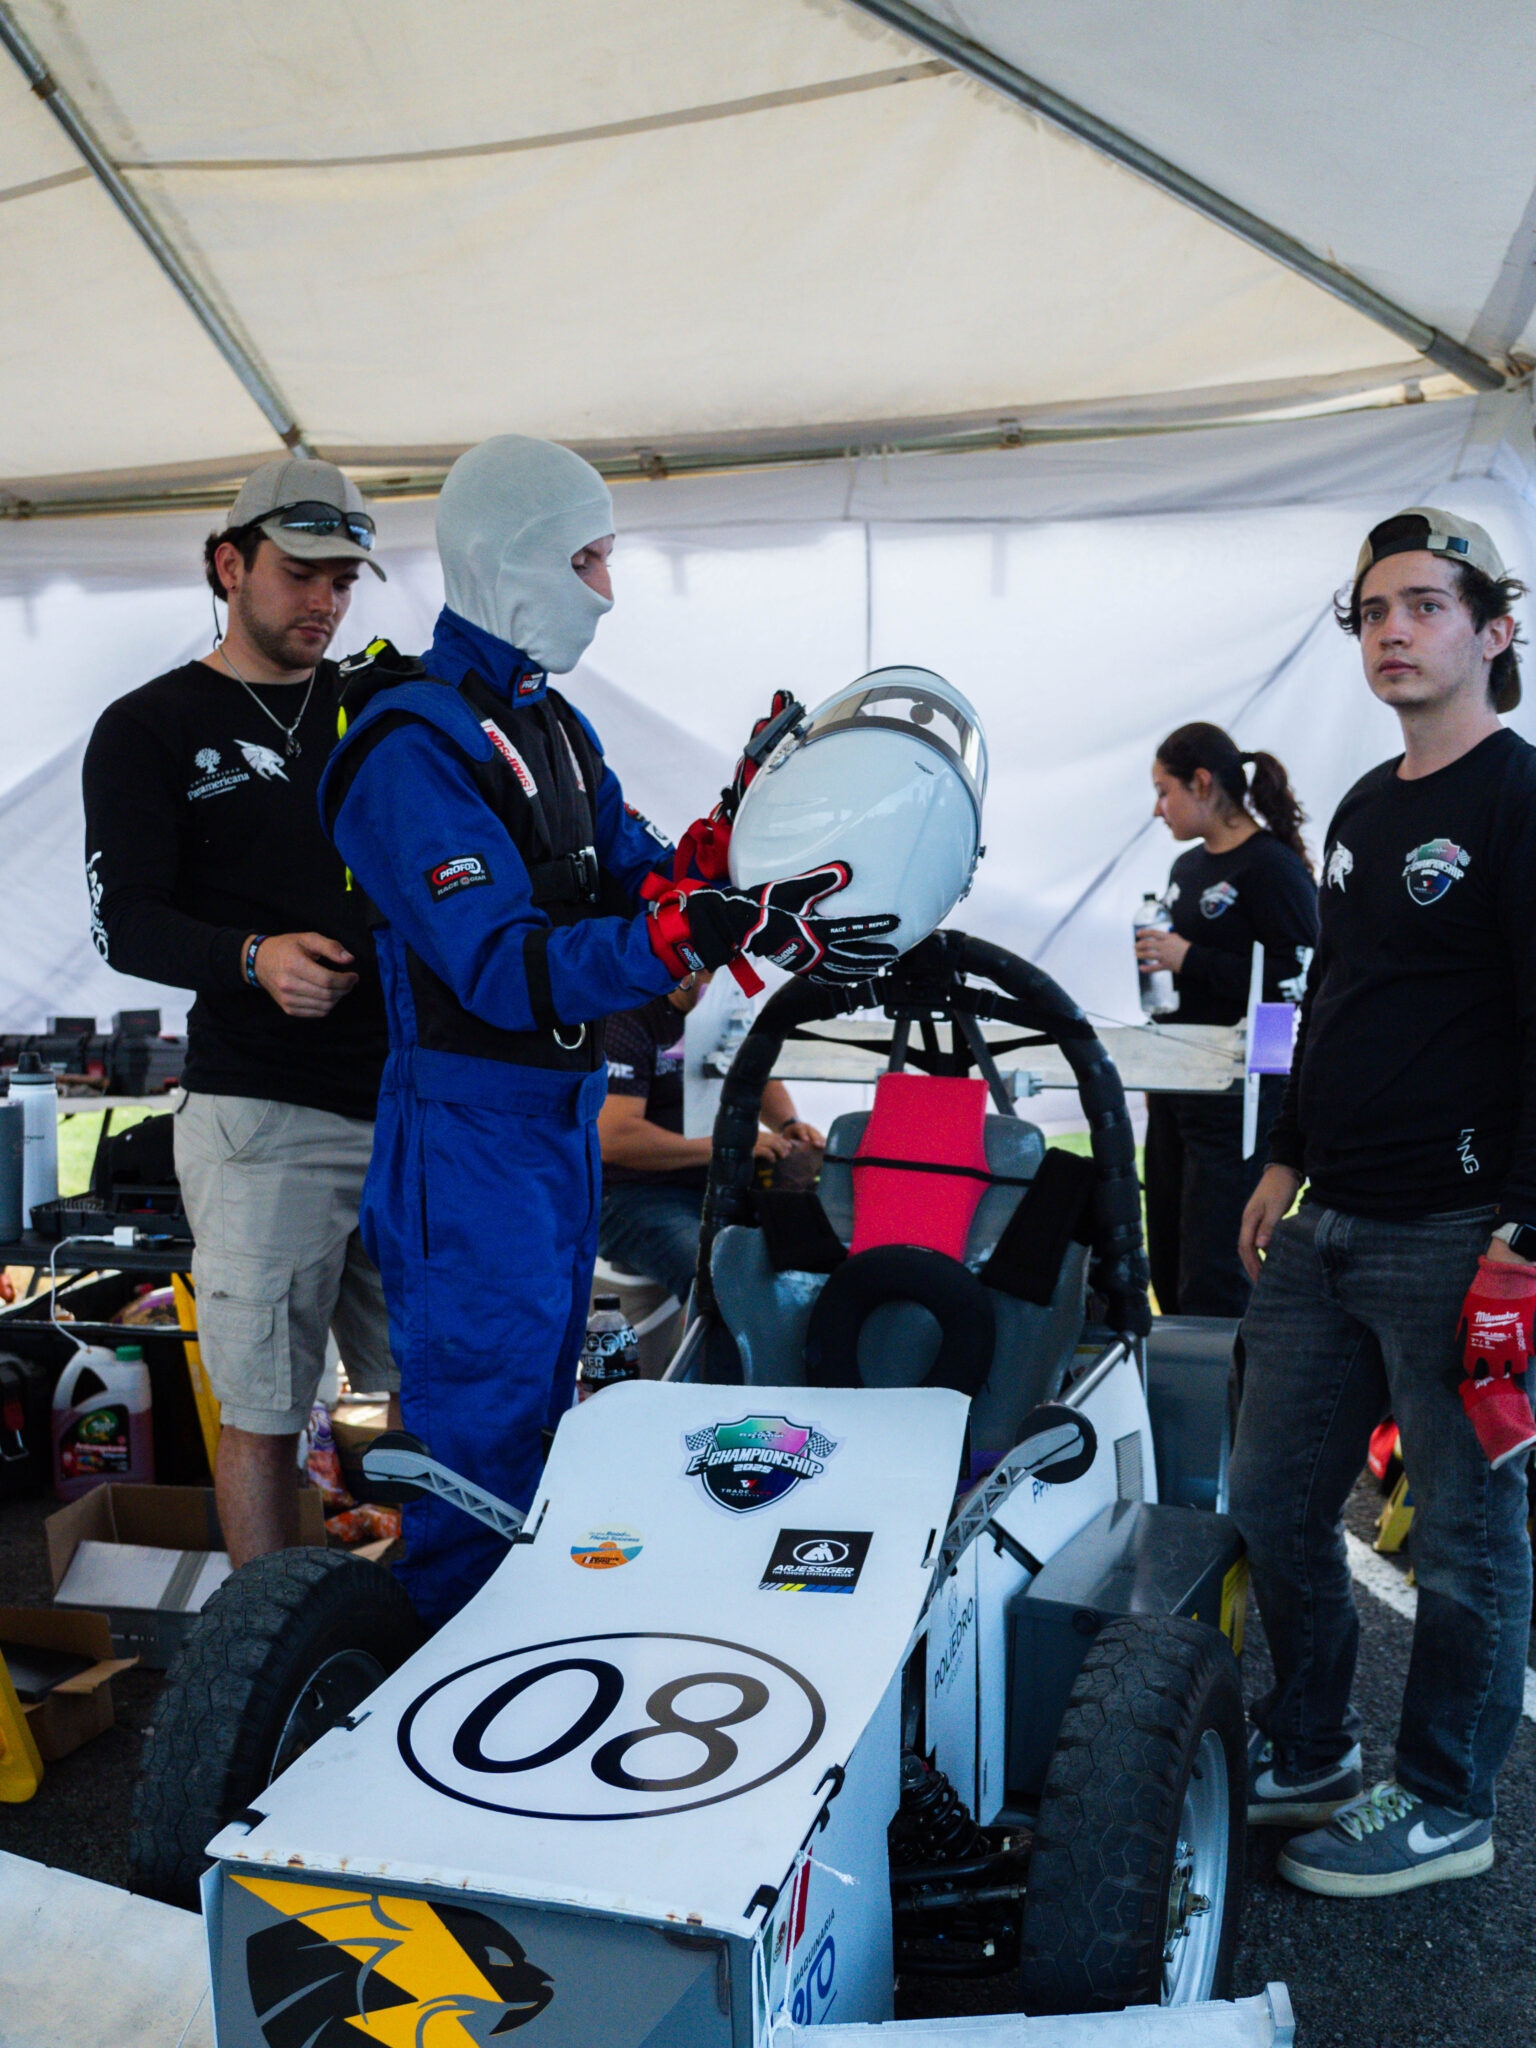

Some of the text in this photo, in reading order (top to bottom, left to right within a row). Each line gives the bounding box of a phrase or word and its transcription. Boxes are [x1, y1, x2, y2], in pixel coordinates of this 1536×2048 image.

[486, 730, 531, 789] SIMPSON
[187, 772, 251, 801] Panamericana
[440, 862, 476, 881] PROFOX
[437, 875, 487, 896] RACE GEAR
[830, 926, 847, 934] RACE
[868, 919, 890, 929] REPEAT
[1475, 1310, 1520, 1324] Milwaukee
[686, 1447, 824, 1477] E-CHAMPIONSHIP
[732, 1462, 774, 1475] 2025
[772, 1564, 855, 1575] ARJESSIGER
[934, 1596, 974, 1699] POLIEDRO
[452, 1657, 770, 1792] 08
[793, 1907, 835, 1990] MAQUINARIA
